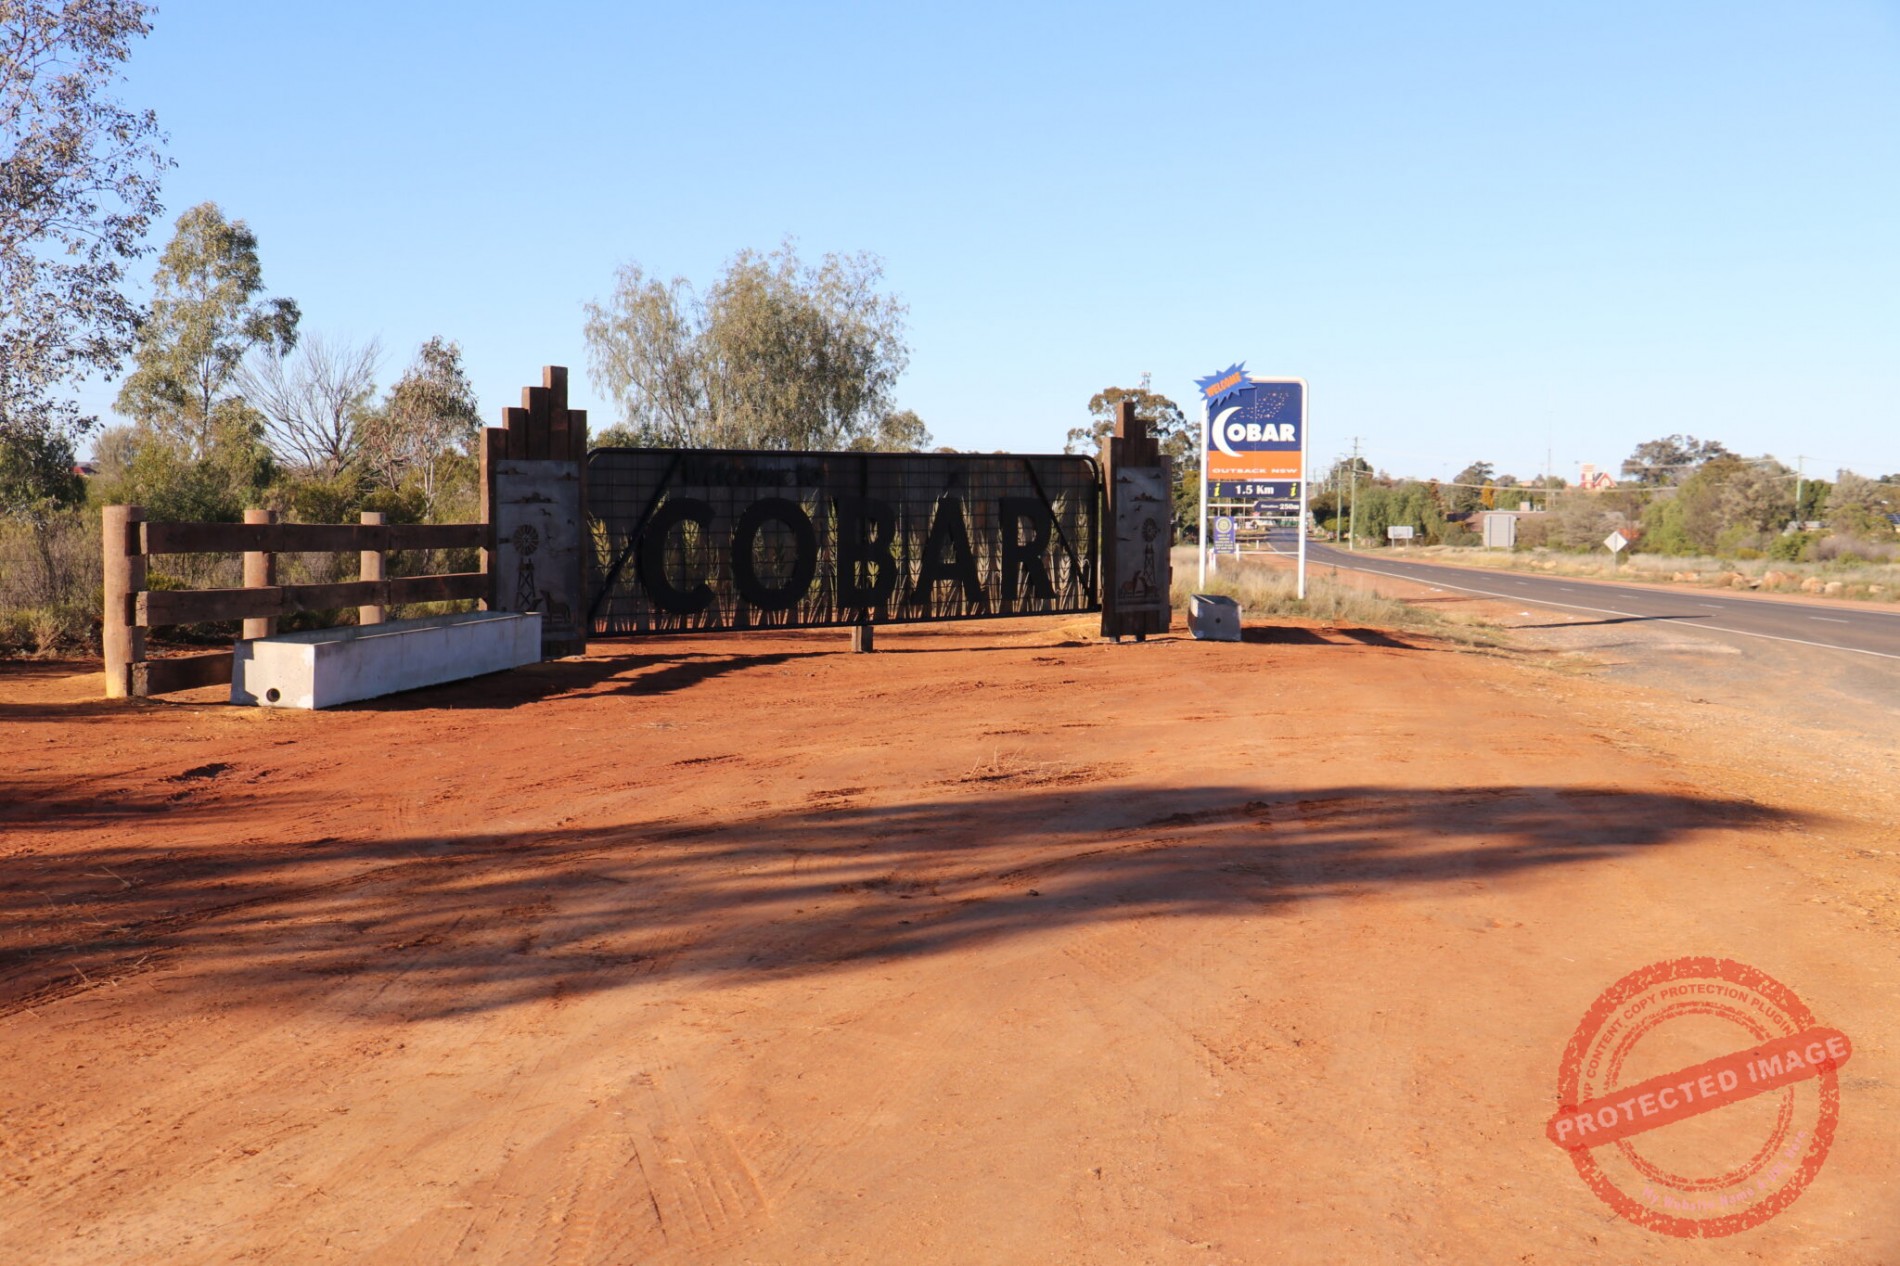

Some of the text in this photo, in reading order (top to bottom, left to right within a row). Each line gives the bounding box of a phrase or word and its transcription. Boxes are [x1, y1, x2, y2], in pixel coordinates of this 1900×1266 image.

[1212, 406, 1296, 457] COBAR
[1235, 485, 1275, 494] 1.5 Km
[637, 496, 1057, 615] COBAR
